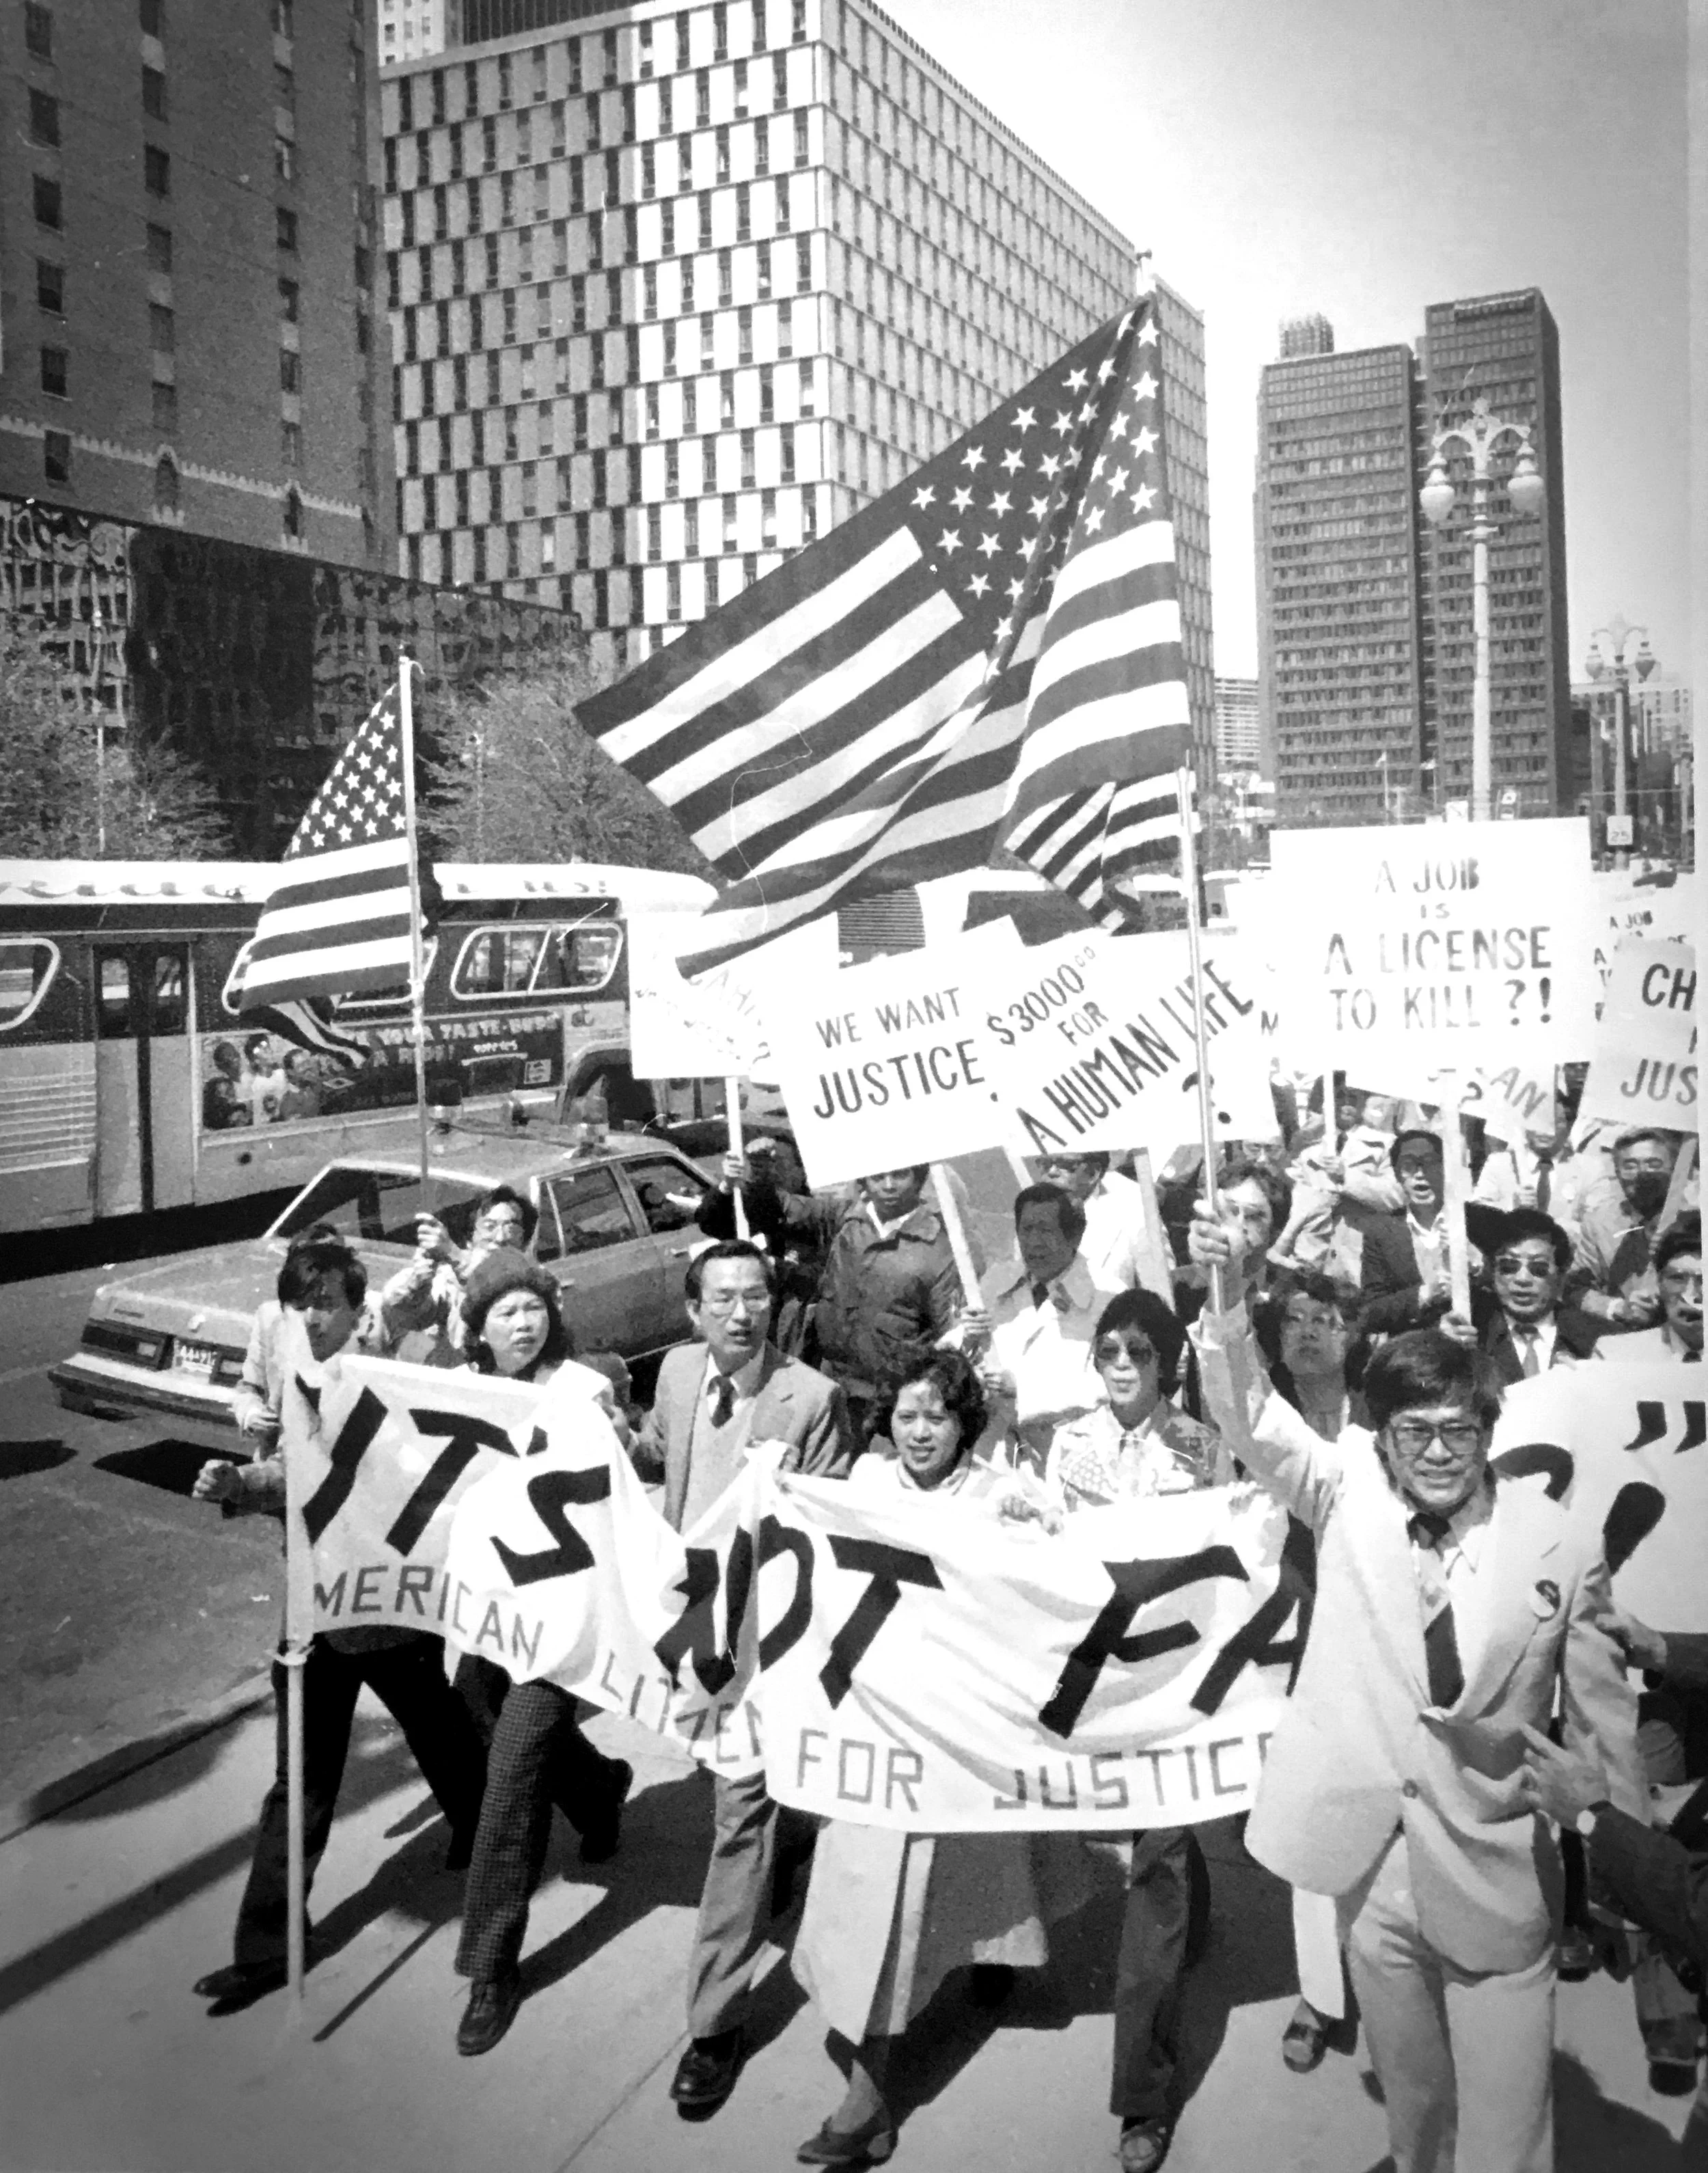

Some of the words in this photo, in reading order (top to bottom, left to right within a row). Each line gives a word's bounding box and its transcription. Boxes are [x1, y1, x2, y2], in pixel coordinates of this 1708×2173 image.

[1375, 859, 1396, 893] A
[1413, 856, 1480, 893] JOB
[1324, 933, 1353, 975] A
[1379, 926, 1552, 974] LICENSE
[816, 1013, 862, 1049] WE
[874, 987, 961, 1035] WANT
[1058, 1001, 1109, 1047] FOR
[1329, 988, 1377, 1031] TO
[1405, 982, 1481, 1029] KILL
[1016, 1106, 1068, 1156] A
[1043, 1013, 1180, 1135] HUMAN
[1159, 959, 1253, 1042] LIFE
[314, 1565, 544, 1671] MERICAN
[797, 1730, 924, 1812] FOR
